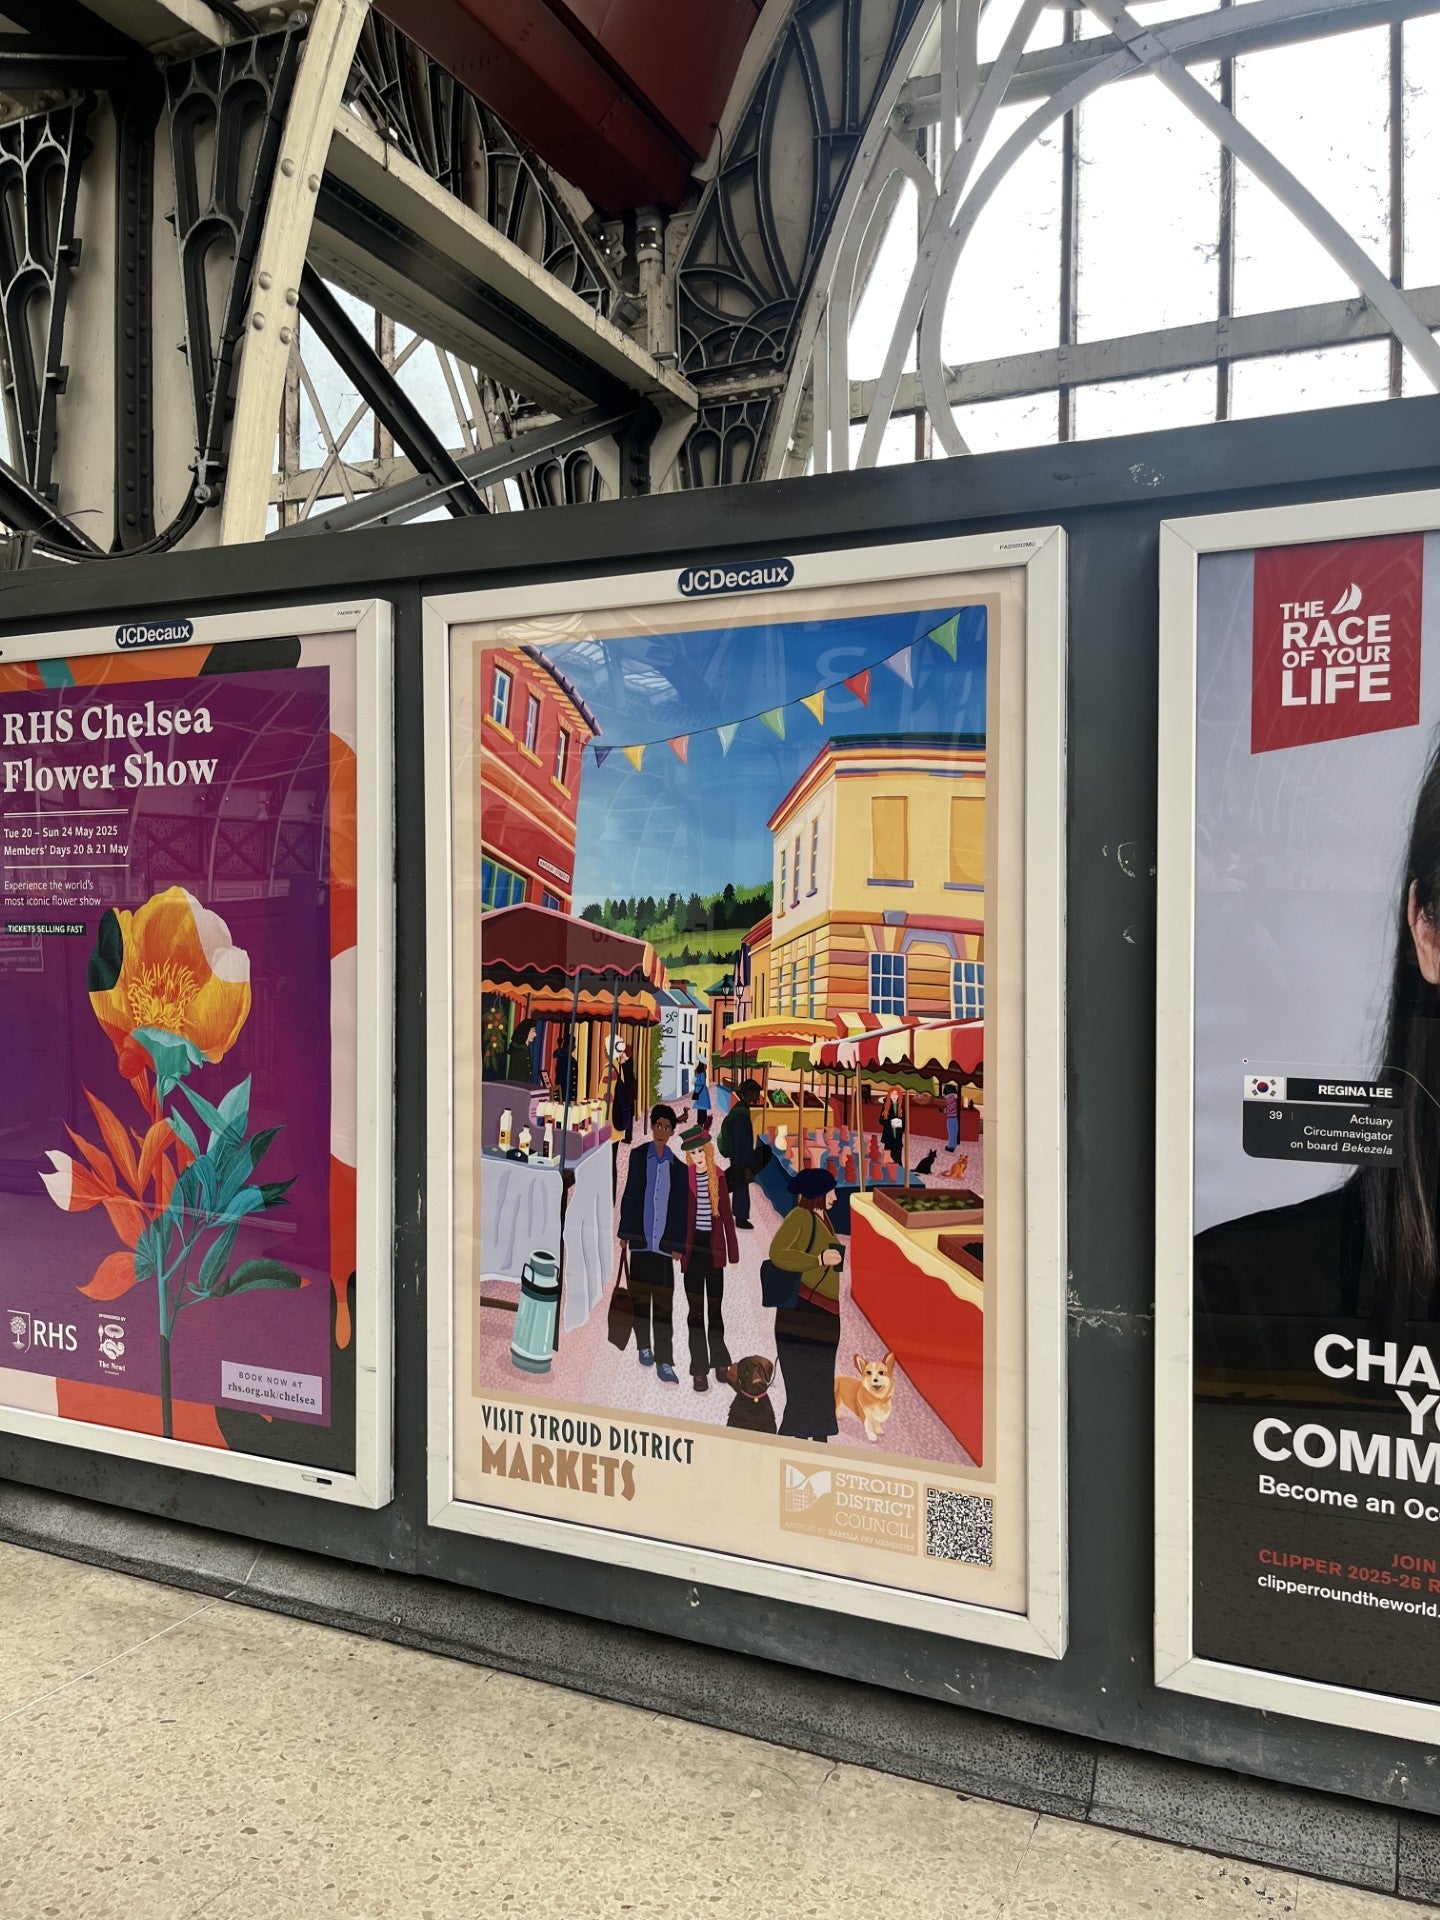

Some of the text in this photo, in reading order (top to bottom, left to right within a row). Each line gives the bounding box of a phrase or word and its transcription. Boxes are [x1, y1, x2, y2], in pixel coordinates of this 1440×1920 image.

[681, 566, 789, 592] JCDecaux
[1280, 600, 1324, 620] THE
[118, 625, 190, 645] JCDecaux
[1282, 614, 1391, 649] RACE
[1282, 645, 1390, 668] OF YOUR
[1282, 664, 1391, 706] LIFE
[2, 702, 214, 745] RHS Chelsea
[3, 750, 218, 793] Flower Show
[4, 828, 19, 838] Tue
[22, 828, 32, 838] 20
[43, 827, 59, 837] Sun
[62, 827, 73, 837] 24
[75, 826, 94, 839] May
[96, 826, 118, 836] 2025
[50, 845, 71, 857] Days
[74, 845, 84, 854] 20
[87, 845, 94, 854] &
[96, 844, 106, 854] 21
[110, 844, 129, 856] May
[4, 880, 47, 893] Experience
[50, 880, 62, 890] the
[4, 895, 101, 906] most iconic flower show
[8, 925, 83, 933] TICKETS SELLING FAST
[1318, 1085, 1393, 1098] REGINA LEE
[1269, 1111, 1283, 1120] 39
[1350, 1114, 1393, 1128] Actuary
[1303, 1126, 1393, 1142] Circumnavigator
[1290, 1141, 1393, 1155] on board Bekezela
[33, 1320, 78, 1351] RHS
[99, 1360, 110, 1369] The
[1313, 1333, 1440, 1391] CHA
[239, 1372, 303, 1389] BOOK NOW AT
[228, 1382, 315, 1406] rhs.org.uk/chelsea
[1395, 1390, 1440, 1436] Y
[481, 1405, 695, 1464] VISIT STROUD DISTRICT
[1253, 1417, 1440, 1486] COMM
[481, 1434, 636, 1501] MARKETS
[835, 1472, 914, 1499] STROUD
[1259, 1474, 1440, 1522] Become an Oc
[835, 1491, 915, 1519] DISTRICT
[835, 1511, 914, 1539] COUNCIL
[1258, 1549, 1342, 1577] CLIPPER
[1348, 1565, 1422, 1590] 2025-26
[1391, 1554, 1436, 1574] JOIN
[1257, 1574, 1440, 1618] clipperroundtheworld.
